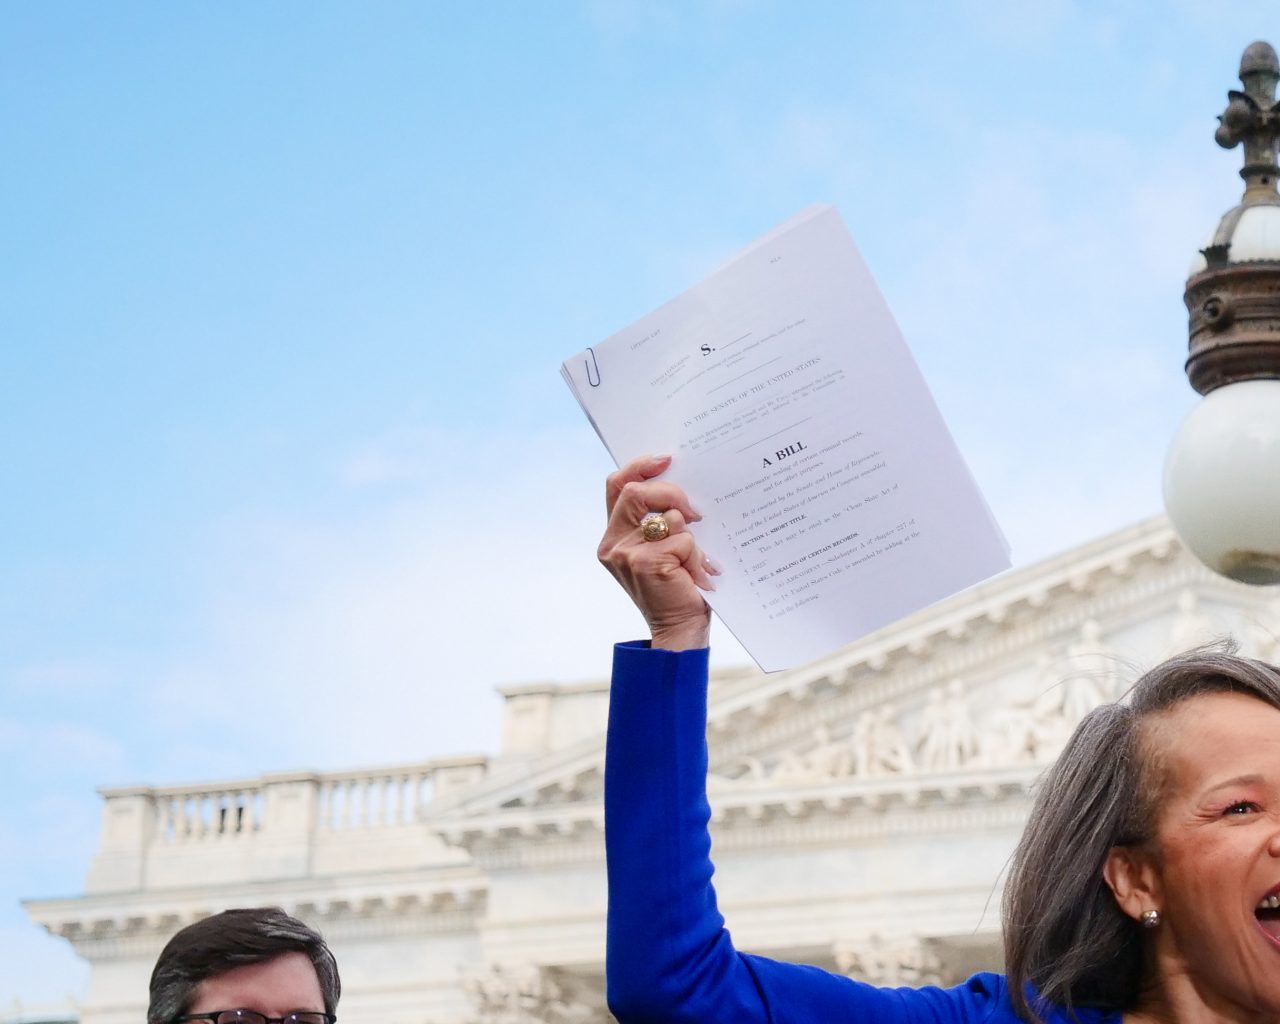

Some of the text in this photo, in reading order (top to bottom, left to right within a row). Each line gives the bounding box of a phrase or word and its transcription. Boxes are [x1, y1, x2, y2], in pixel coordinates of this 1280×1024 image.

[701, 343, 715, 356] S.
[762, 441, 807, 468] A BILL
